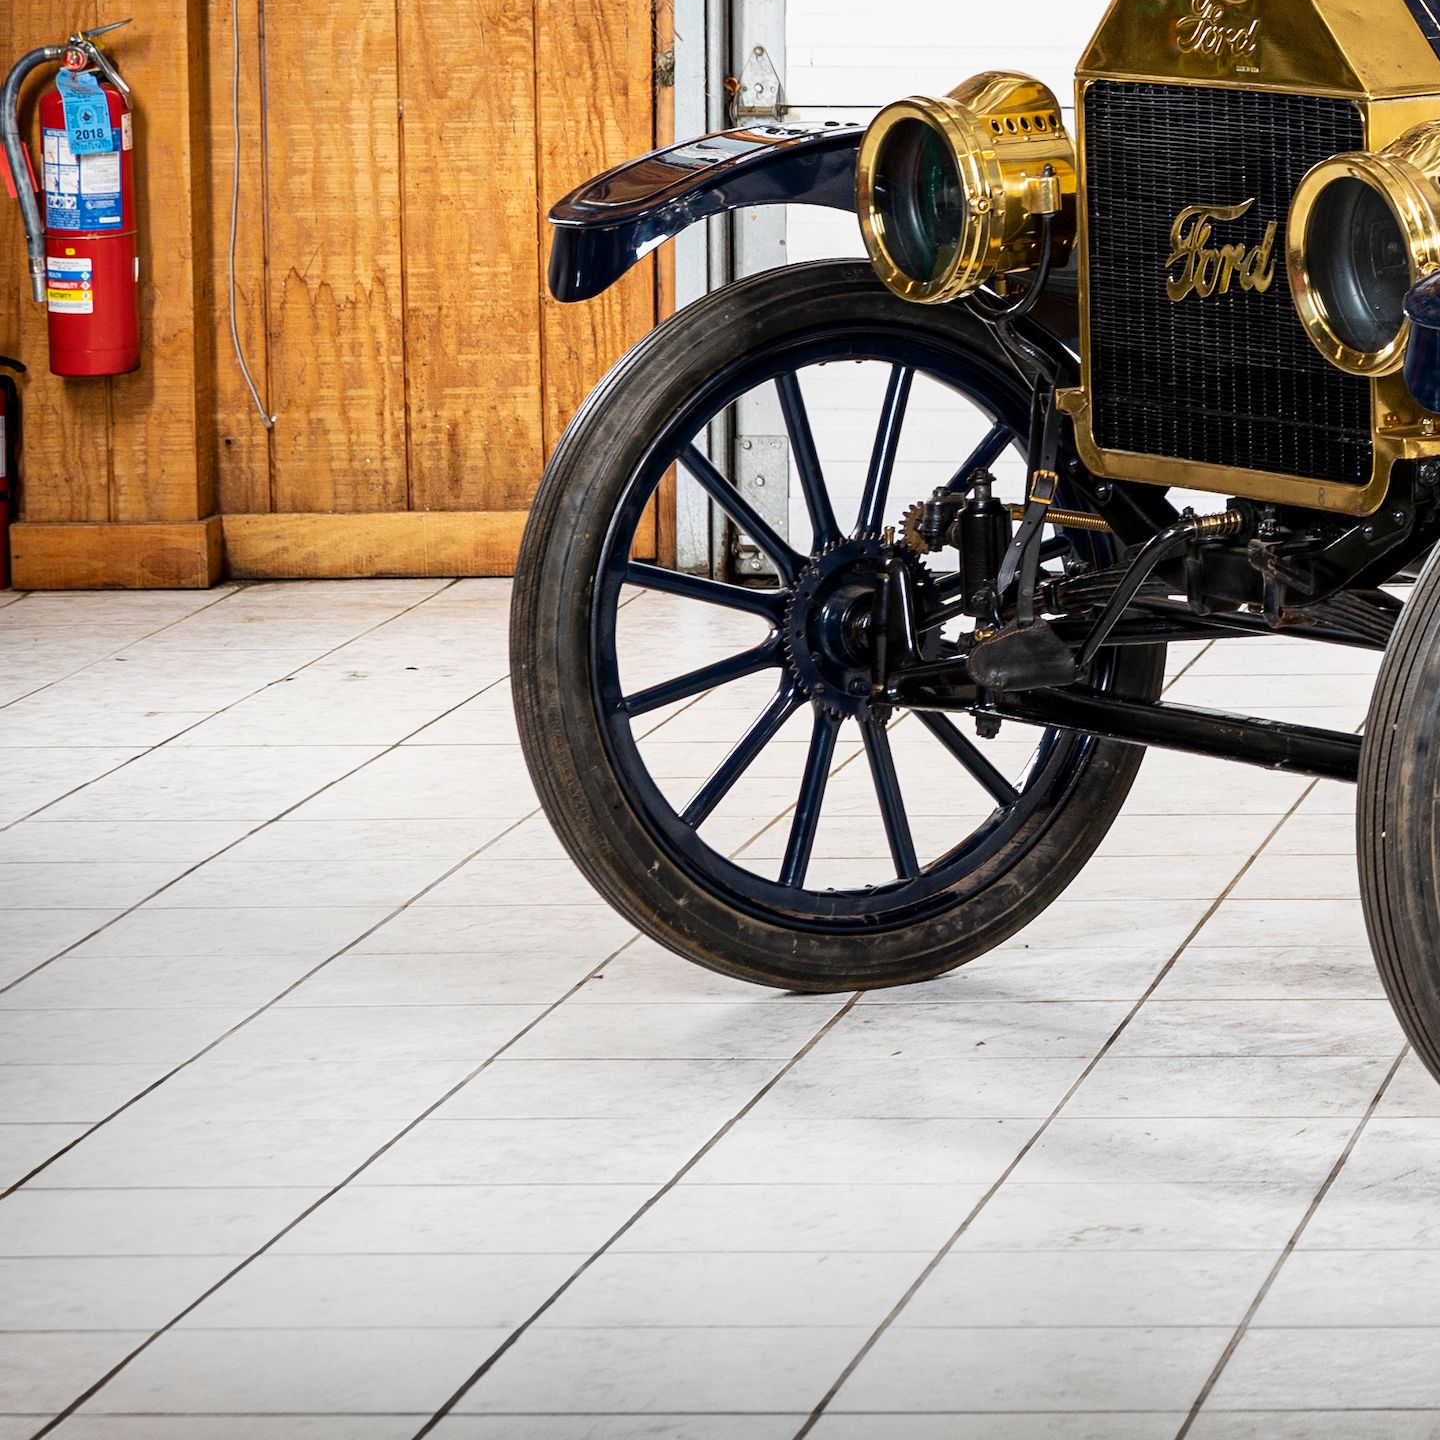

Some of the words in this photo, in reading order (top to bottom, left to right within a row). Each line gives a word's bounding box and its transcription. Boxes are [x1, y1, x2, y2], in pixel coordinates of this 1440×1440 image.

[1176, 16, 1261, 58] Ford
[75, 128, 104, 140] 2018
[1165, 197, 1278, 303] Ford
